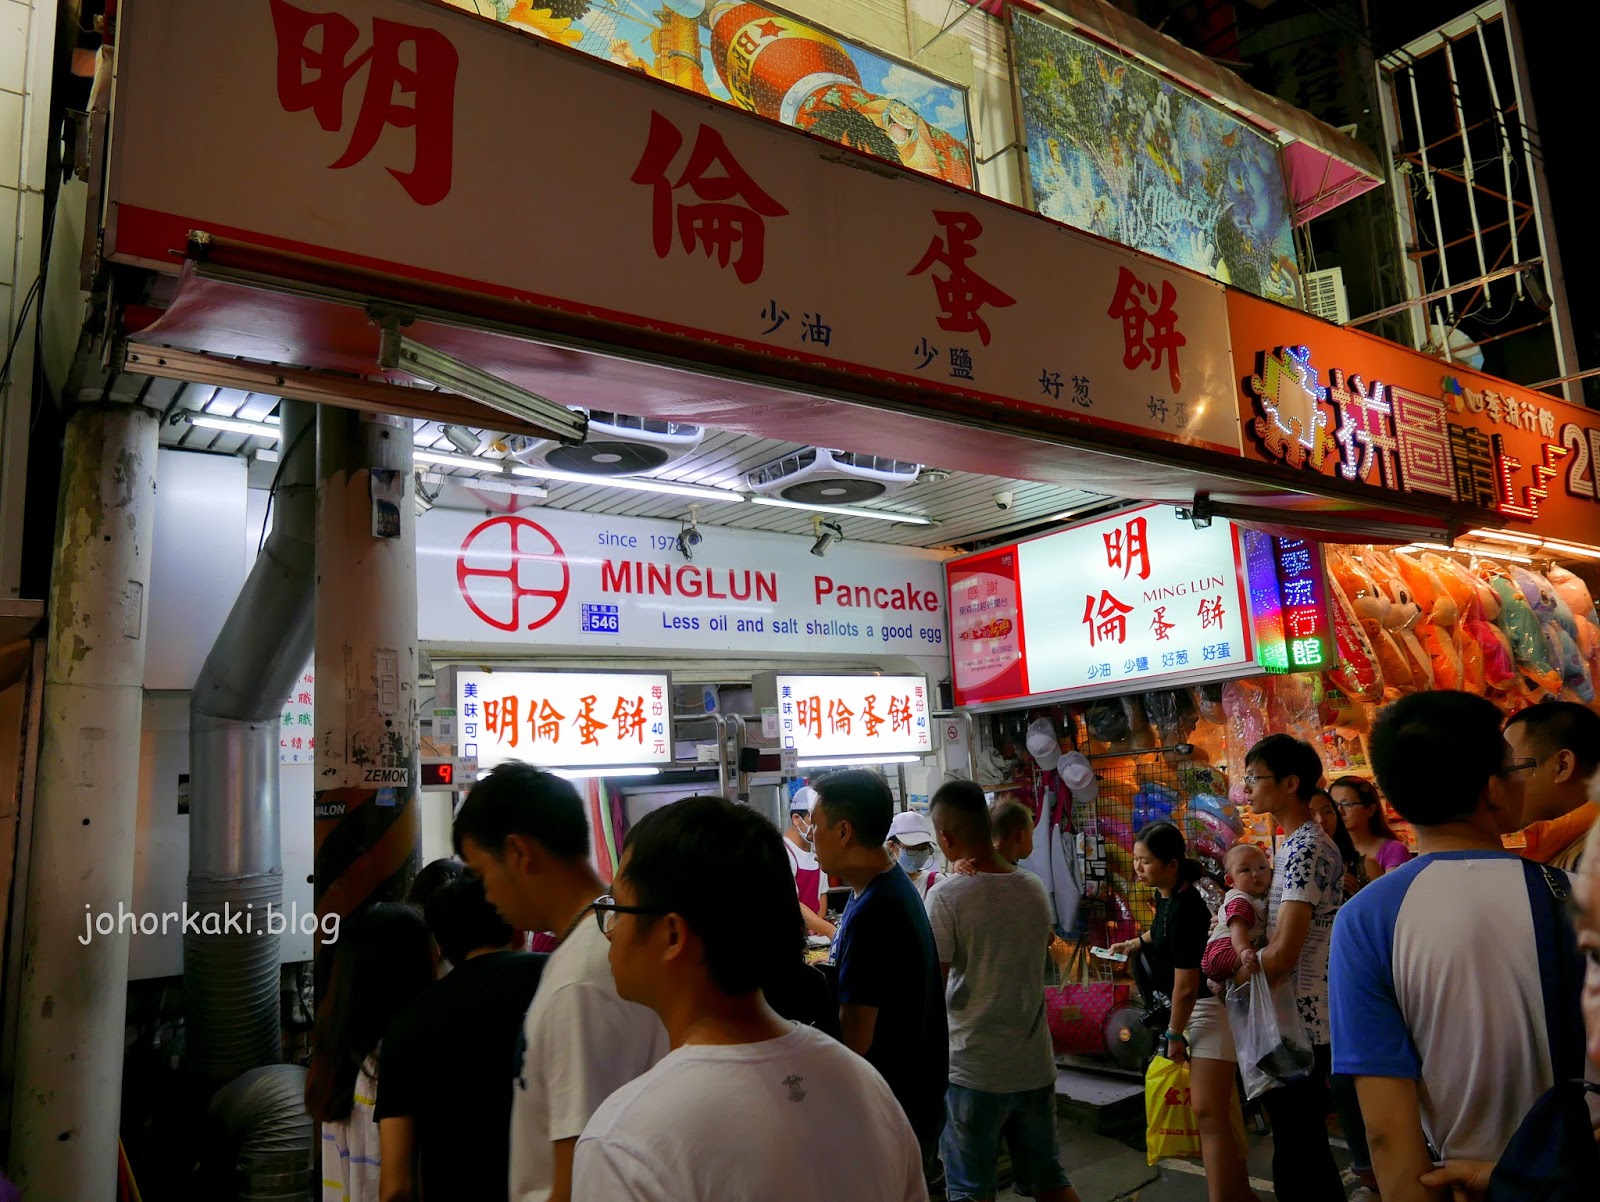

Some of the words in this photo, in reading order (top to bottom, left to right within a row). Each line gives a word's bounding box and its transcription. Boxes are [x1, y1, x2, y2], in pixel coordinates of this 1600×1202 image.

[761, 299, 833, 347] 少油
[914, 337, 975, 381] 少鹽
[598, 531, 637, 548] since
[601, 559, 778, 603] MINGLUN
[814, 576, 939, 613] Pancake
[1143, 583, 1187, 603] MING
[1190, 575, 1224, 593] LUN
[591, 615, 618, 630] 546
[663, 612, 700, 631] Less
[709, 614, 728, 632] oil
[737, 616, 764, 633] and
[773, 617, 798, 634] salt
[806, 619, 859, 637] shallots
[866, 626, 874, 638] a
[881, 623, 913, 642] good
[920, 626, 942, 644] egg
[1087, 662, 1112, 680] 少油
[1124, 656, 1150, 674] 少鹽
[1202, 642, 1231, 661] 好蛋
[464, 683, 479, 758] 美味可口
[483, 694, 648, 748] 明倫蛋餅
[782, 685, 795, 749] 美味可口
[796, 694, 913, 740] 明倫蛋餅
[364, 769, 407, 783] ZEMOK
[439, 765, 452, 783] 9
